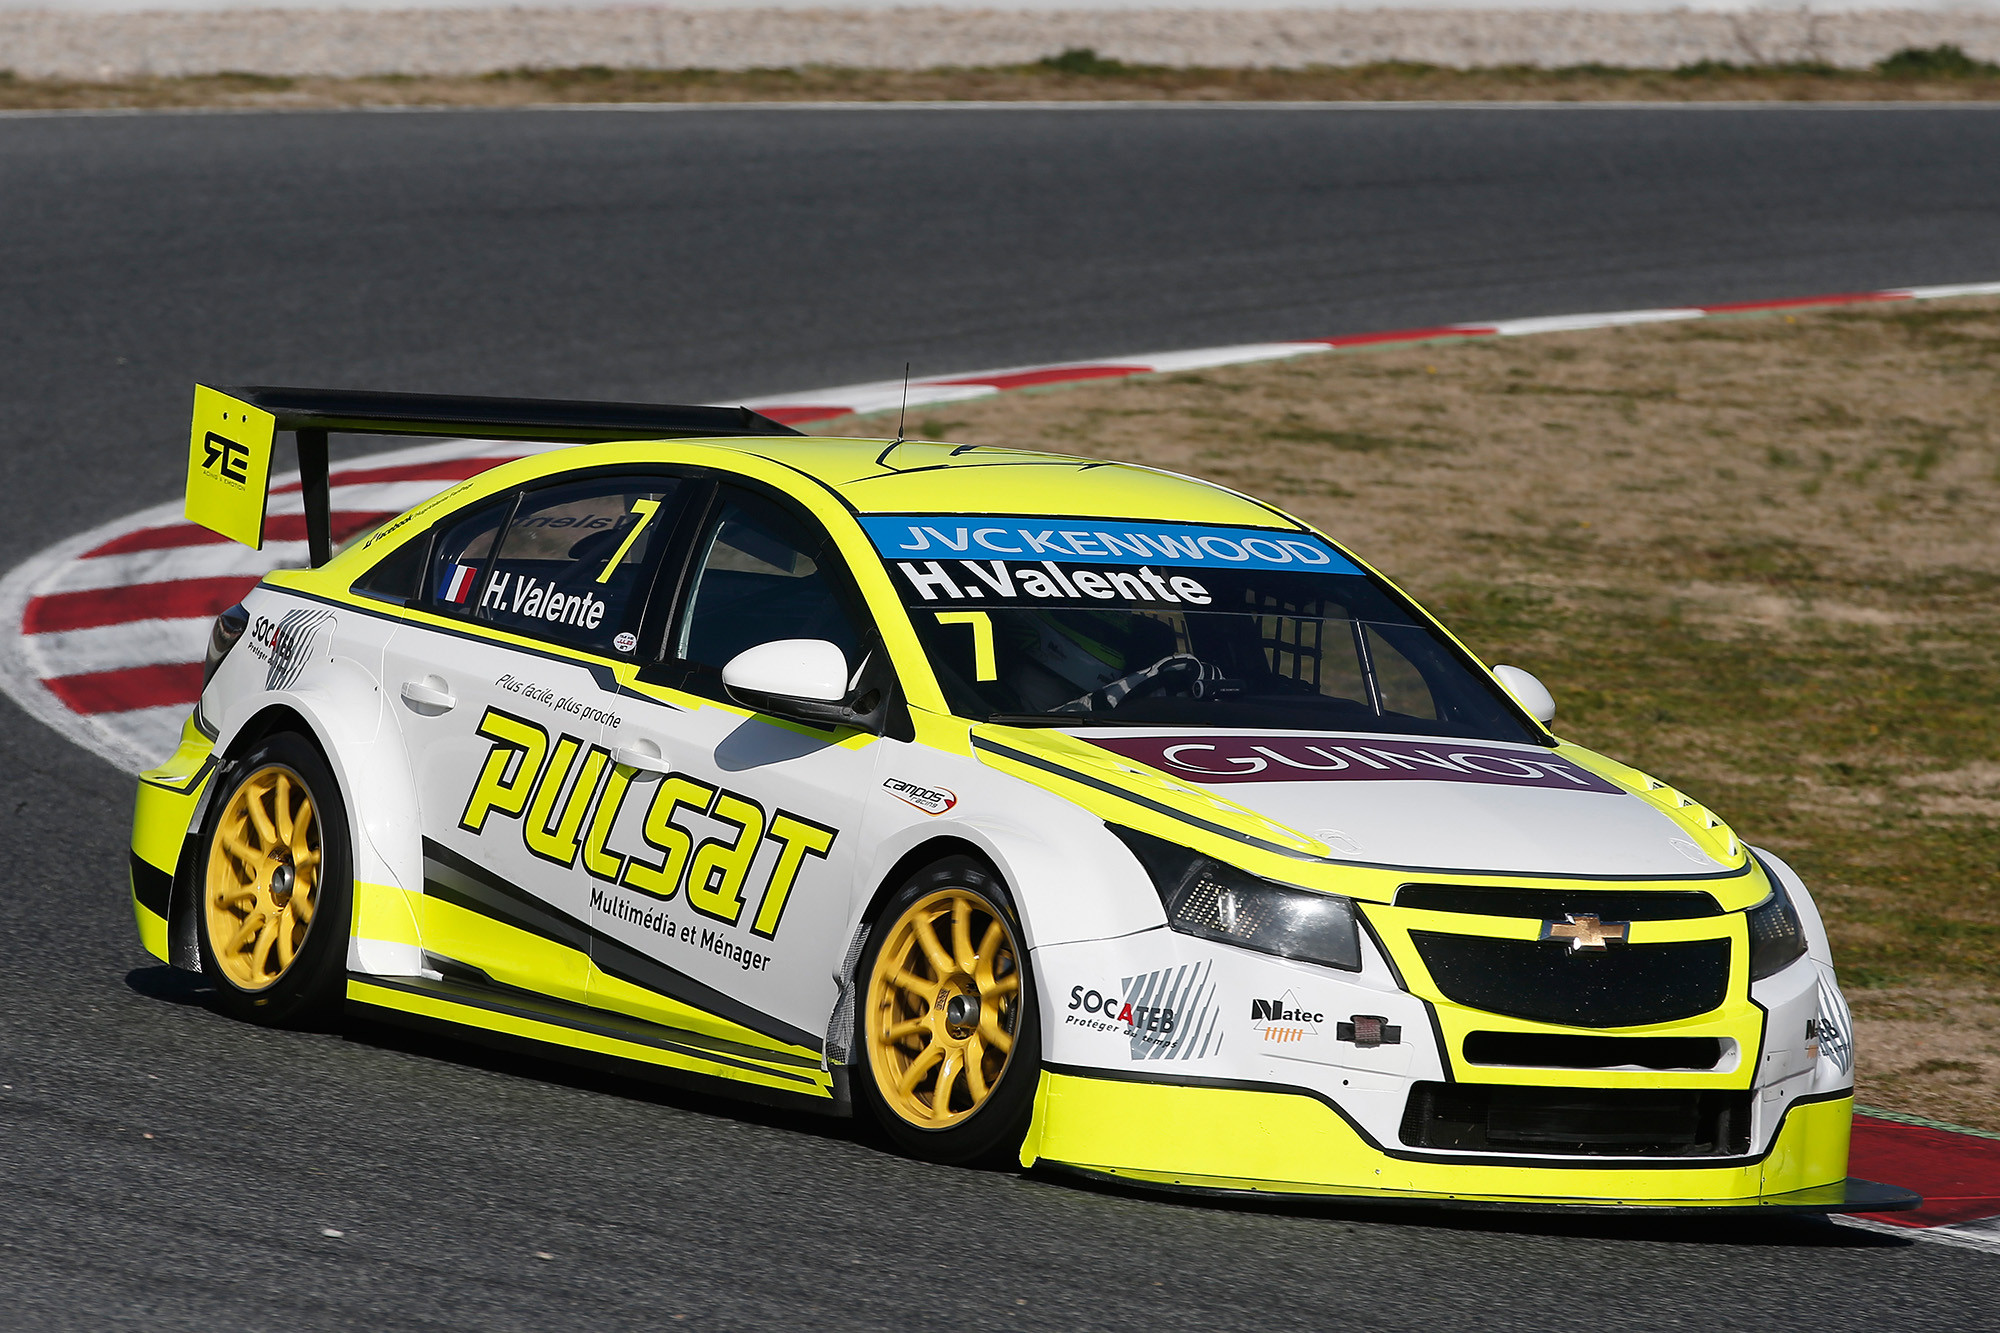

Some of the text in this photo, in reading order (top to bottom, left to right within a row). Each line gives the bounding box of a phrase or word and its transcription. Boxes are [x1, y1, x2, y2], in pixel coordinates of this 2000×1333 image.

[595, 498, 661, 584] 7
[934, 611, 998, 683] 7
[495, 673, 622, 729] Plus facile, plus proche
[1162, 743, 1591, 786] GUINOT
[910, 796, 938, 809] racing
[589, 887, 771, 971] Multimédia et Ménager
[1065, 1015, 1178, 1049] Protéger du temps
[1068, 985, 1175, 1034] SOCATEB
[1251, 998, 1324, 1023] Natec
